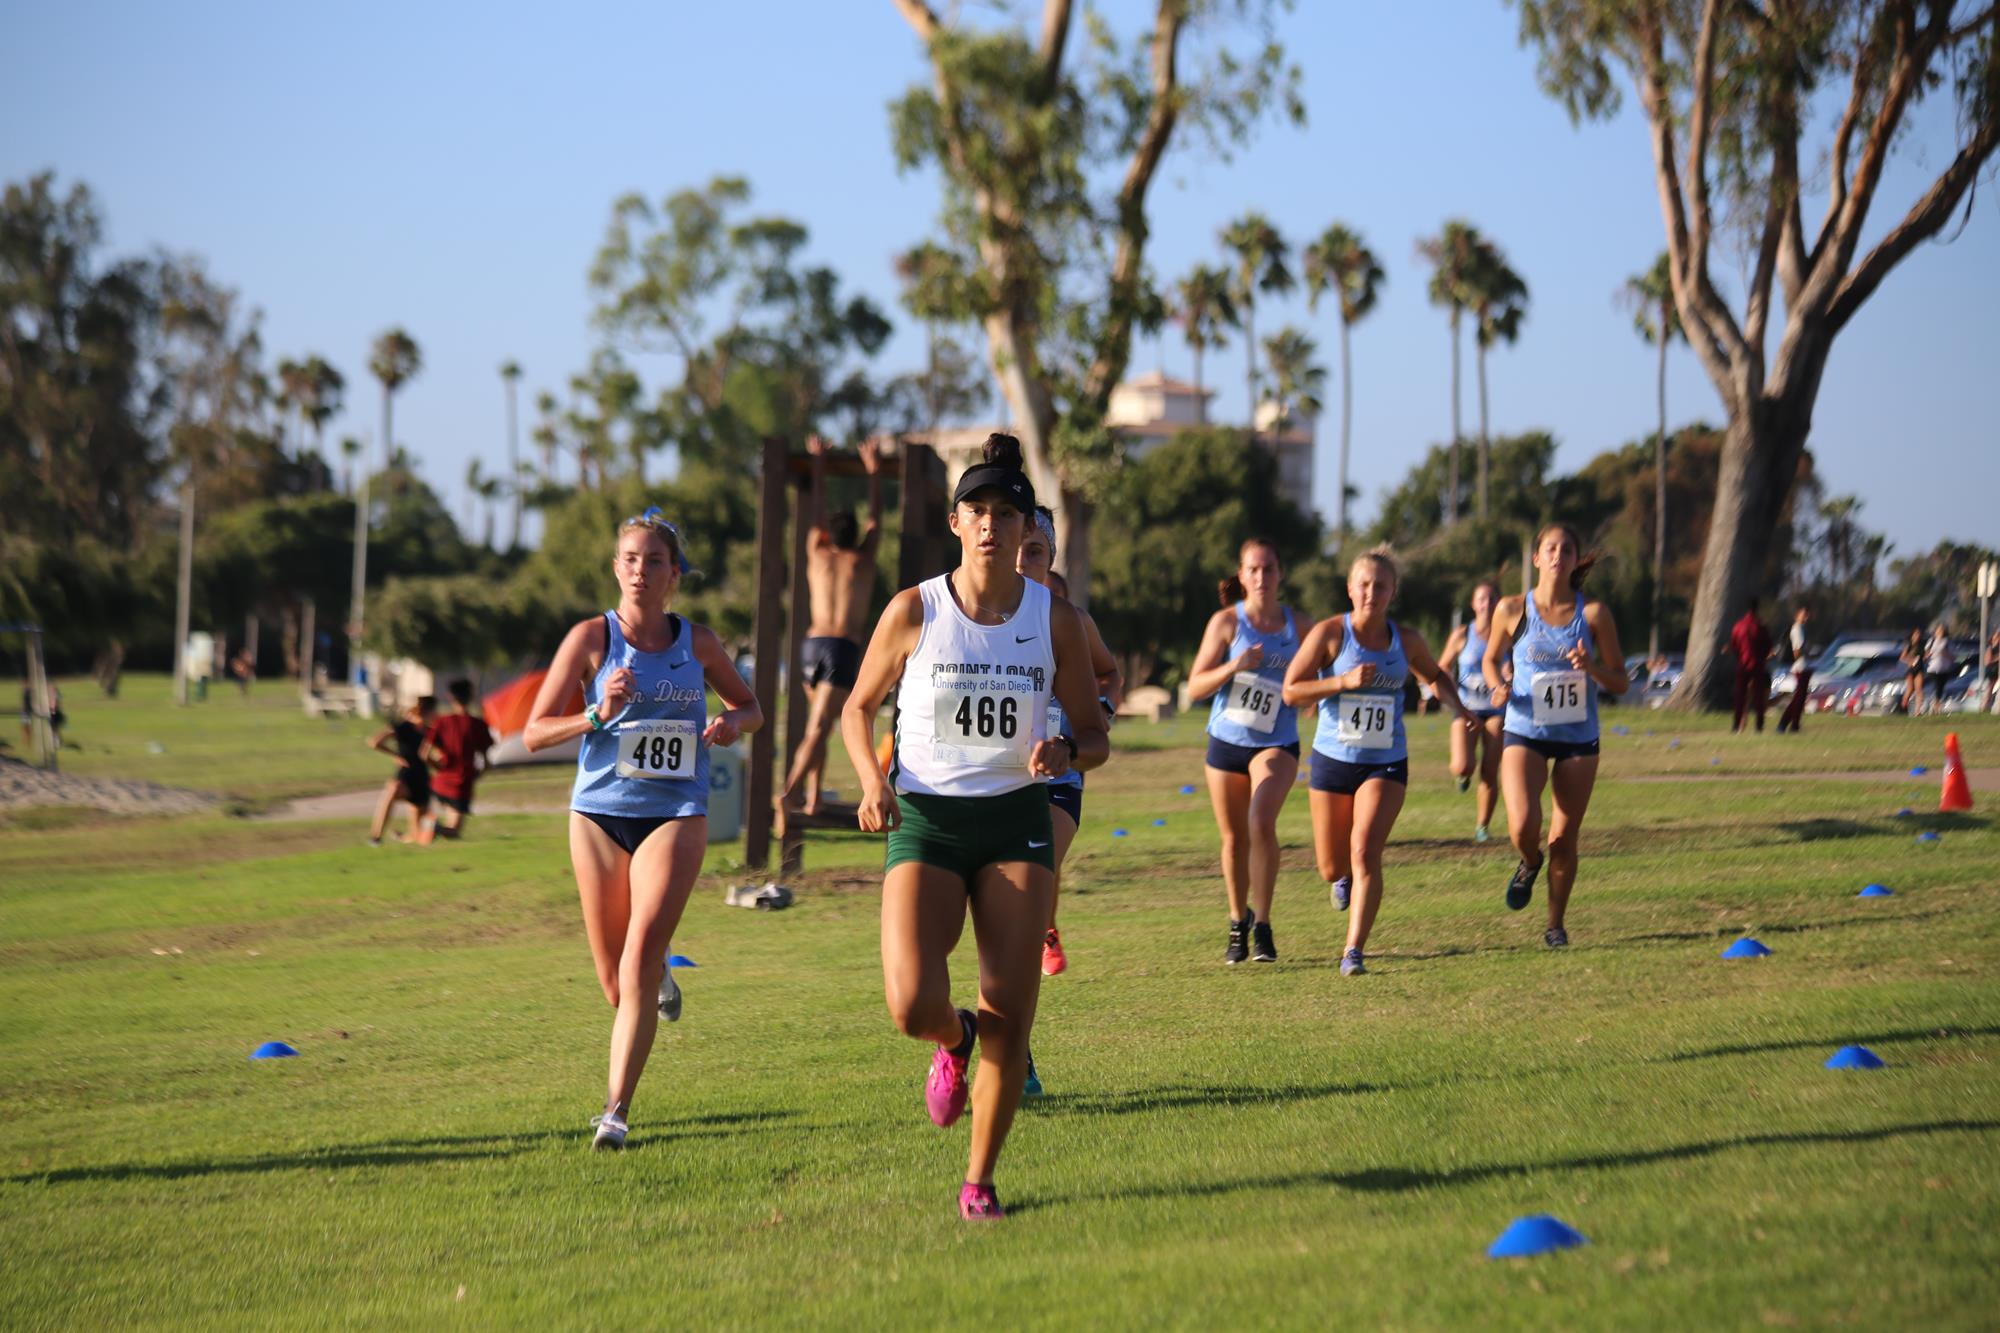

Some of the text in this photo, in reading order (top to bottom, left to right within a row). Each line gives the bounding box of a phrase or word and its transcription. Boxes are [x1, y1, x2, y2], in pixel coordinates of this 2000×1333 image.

[654, 680, 702, 711] Diego
[936, 679, 1032, 694] University of San Diego
[1240, 686, 1275, 716] 495
[1544, 684, 1578, 709] 475
[955, 695, 1018, 739] 466
[1351, 706, 1386, 732] 479
[632, 735, 683, 771] 489
